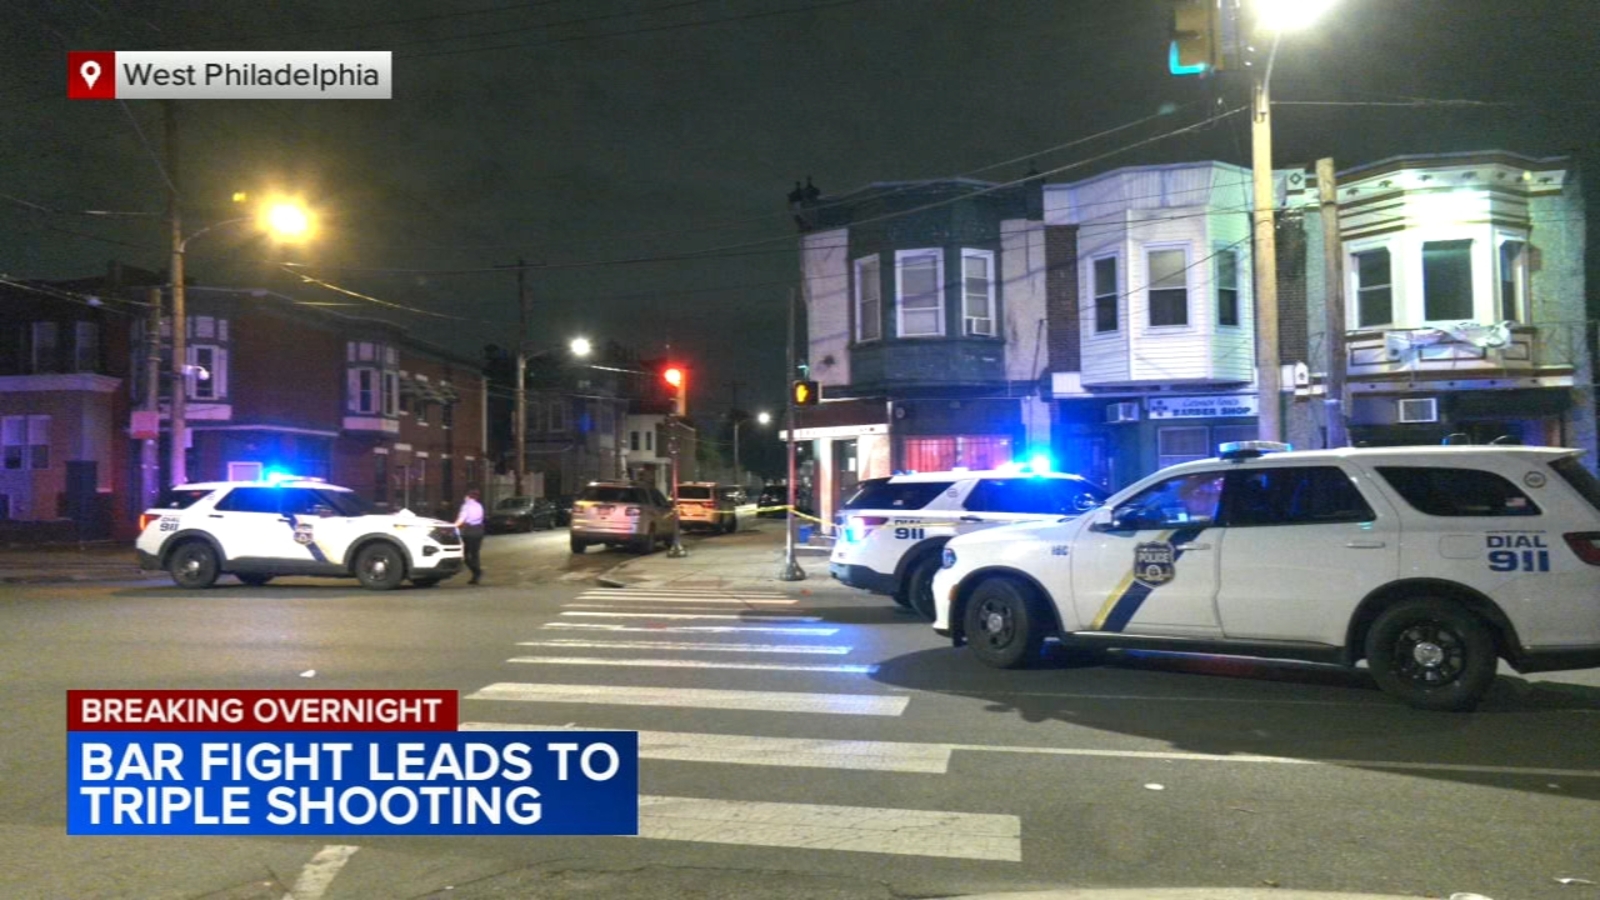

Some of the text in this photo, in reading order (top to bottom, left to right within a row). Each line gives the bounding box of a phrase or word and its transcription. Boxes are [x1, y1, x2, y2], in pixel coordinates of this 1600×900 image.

[1221, 407, 1251, 415] SHOP
[895, 527, 924, 539] 911
[1486, 535, 1547, 548] DIAL
[1138, 552, 1169, 563] POLICE
[1488, 550, 1549, 572] 911
